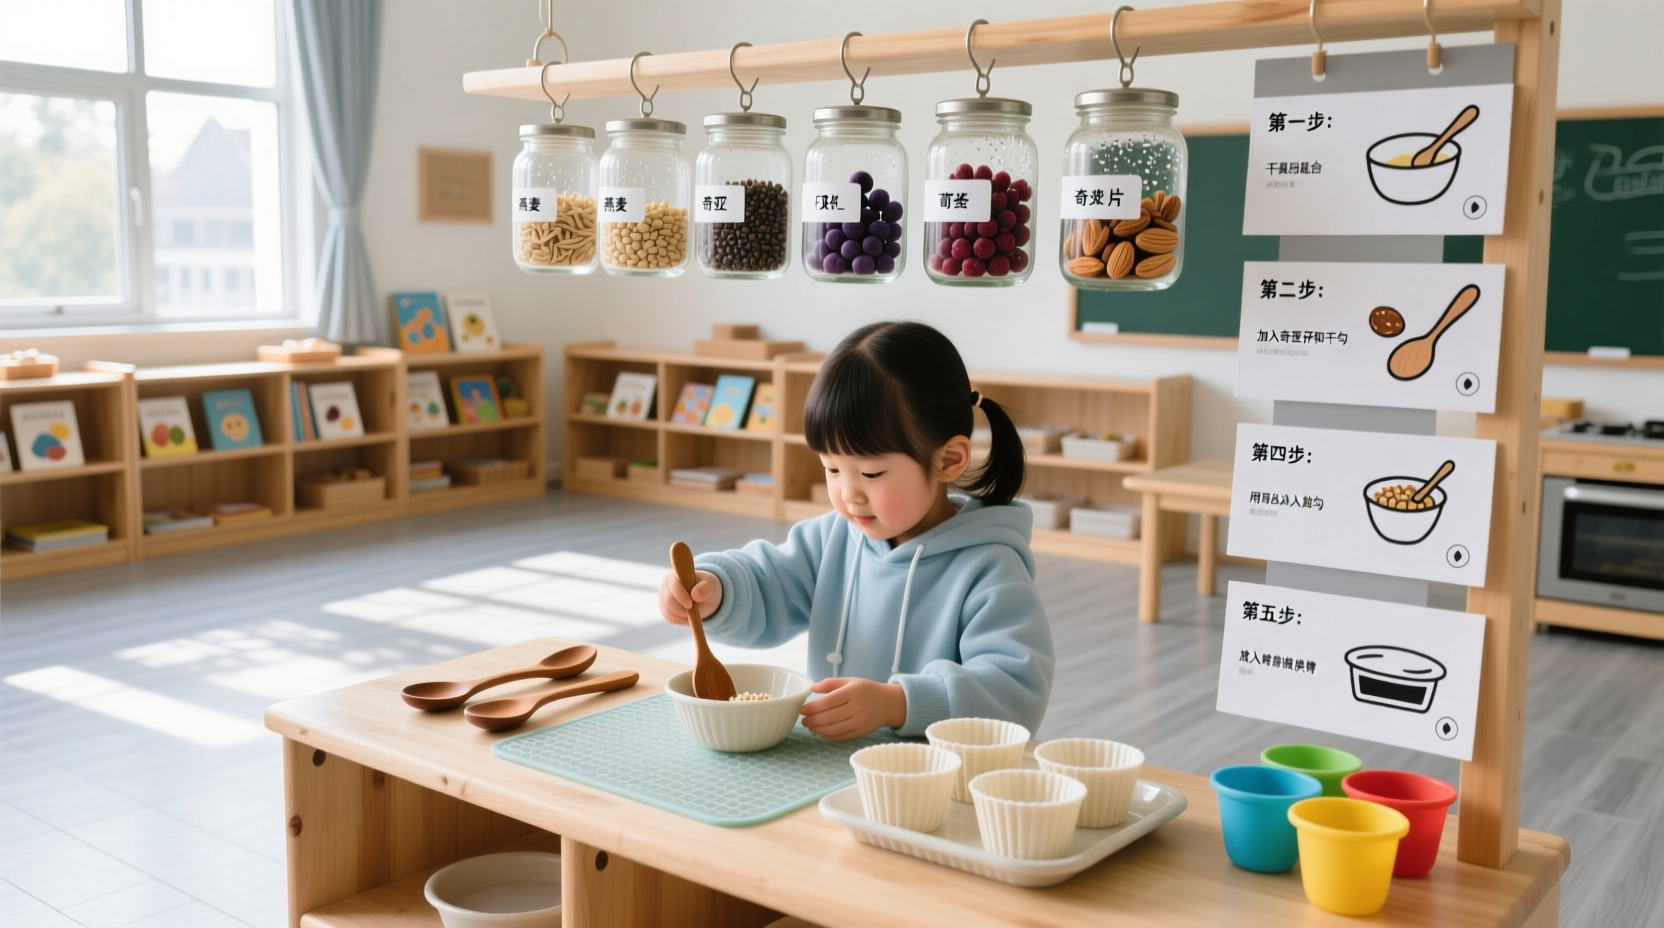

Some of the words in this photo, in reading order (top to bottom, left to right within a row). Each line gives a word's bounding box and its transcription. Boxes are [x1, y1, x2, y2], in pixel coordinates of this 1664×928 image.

[1268, 111, 1333, 133] 第一步:
[1260, 278, 1325, 300] 第二步:
[1251, 442, 1312, 465] 第四步:
[1242, 601, 1302, 625] 第五步:
